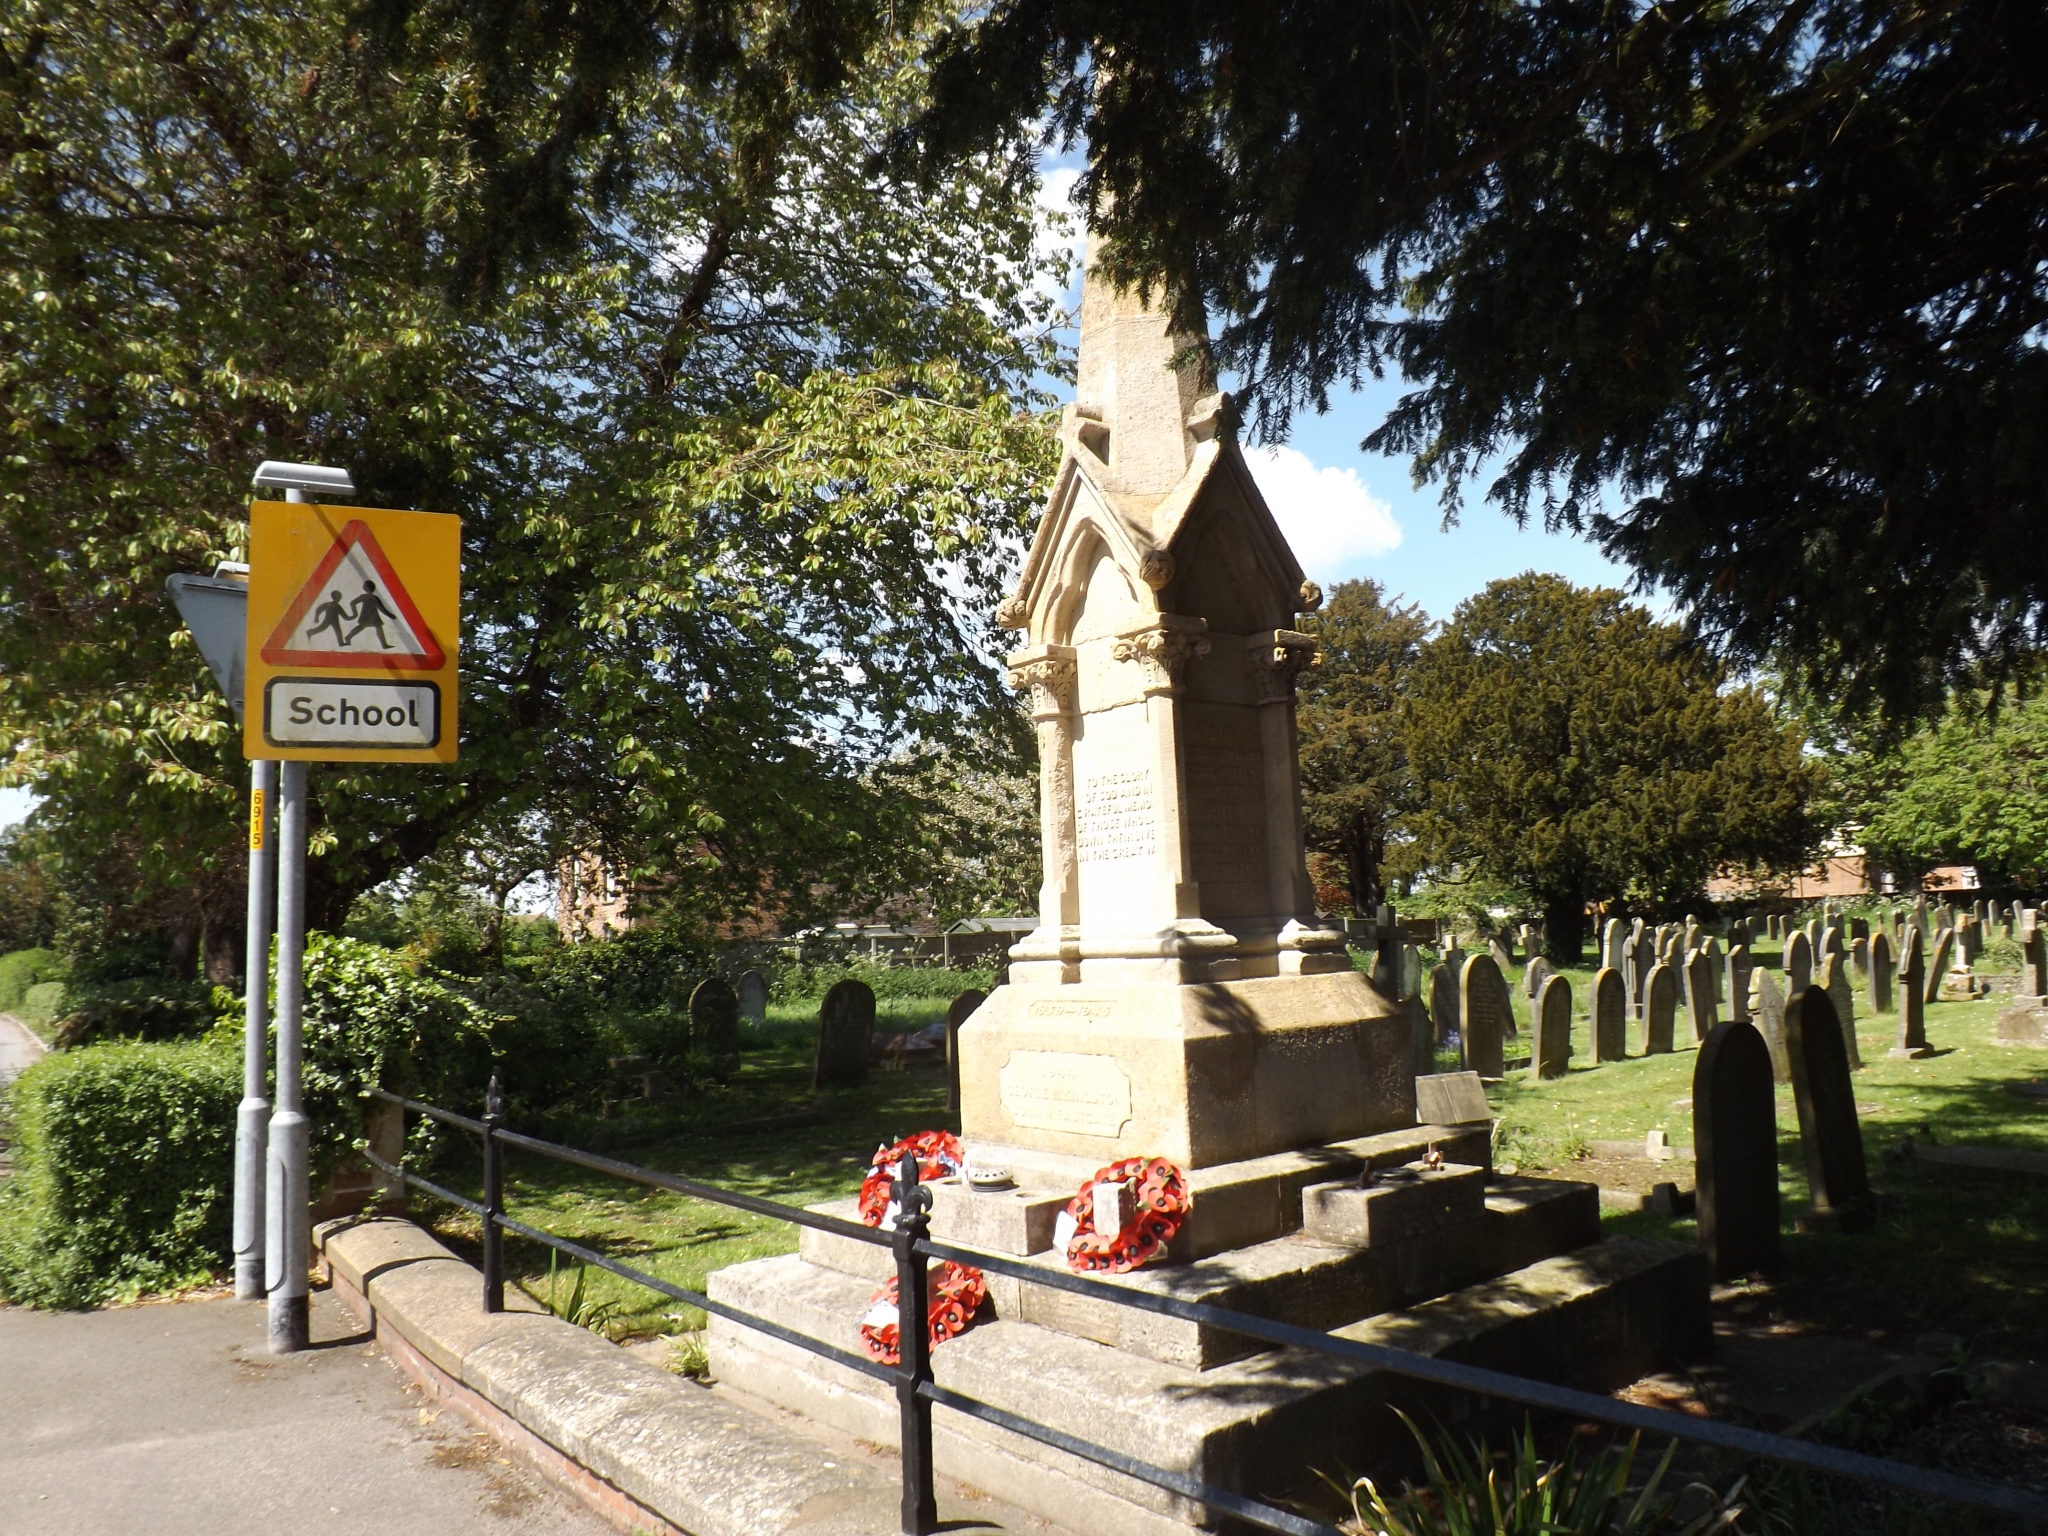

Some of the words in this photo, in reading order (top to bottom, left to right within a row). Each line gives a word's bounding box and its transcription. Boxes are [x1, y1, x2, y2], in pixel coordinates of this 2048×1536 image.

[288, 696, 419, 727] School
[1087, 778, 1098, 788] TO
[1101, 774, 1118, 786] THE
[1120, 768, 1149, 784] GLORY
[1086, 792, 1097, 803] OF
[1100, 789, 1118, 801] GOD
[1120, 786, 1141, 798] AND
[1143, 783, 1153, 795] IN
[253, 792, 262, 845] 6915
[1077, 804, 1123, 819] GRATEFUL
[1077, 822, 1088, 833] OF
[1090, 818, 1120, 832] THOSE
[1124, 816, 1144, 828] WHO
[1078, 836, 1104, 848] DOWN
[1108, 832, 1134, 845] THEIR
[1079, 851, 1089, 863] IN
[1093, 849, 1109, 861] THE
[1113, 846, 1143, 859] GREAT
